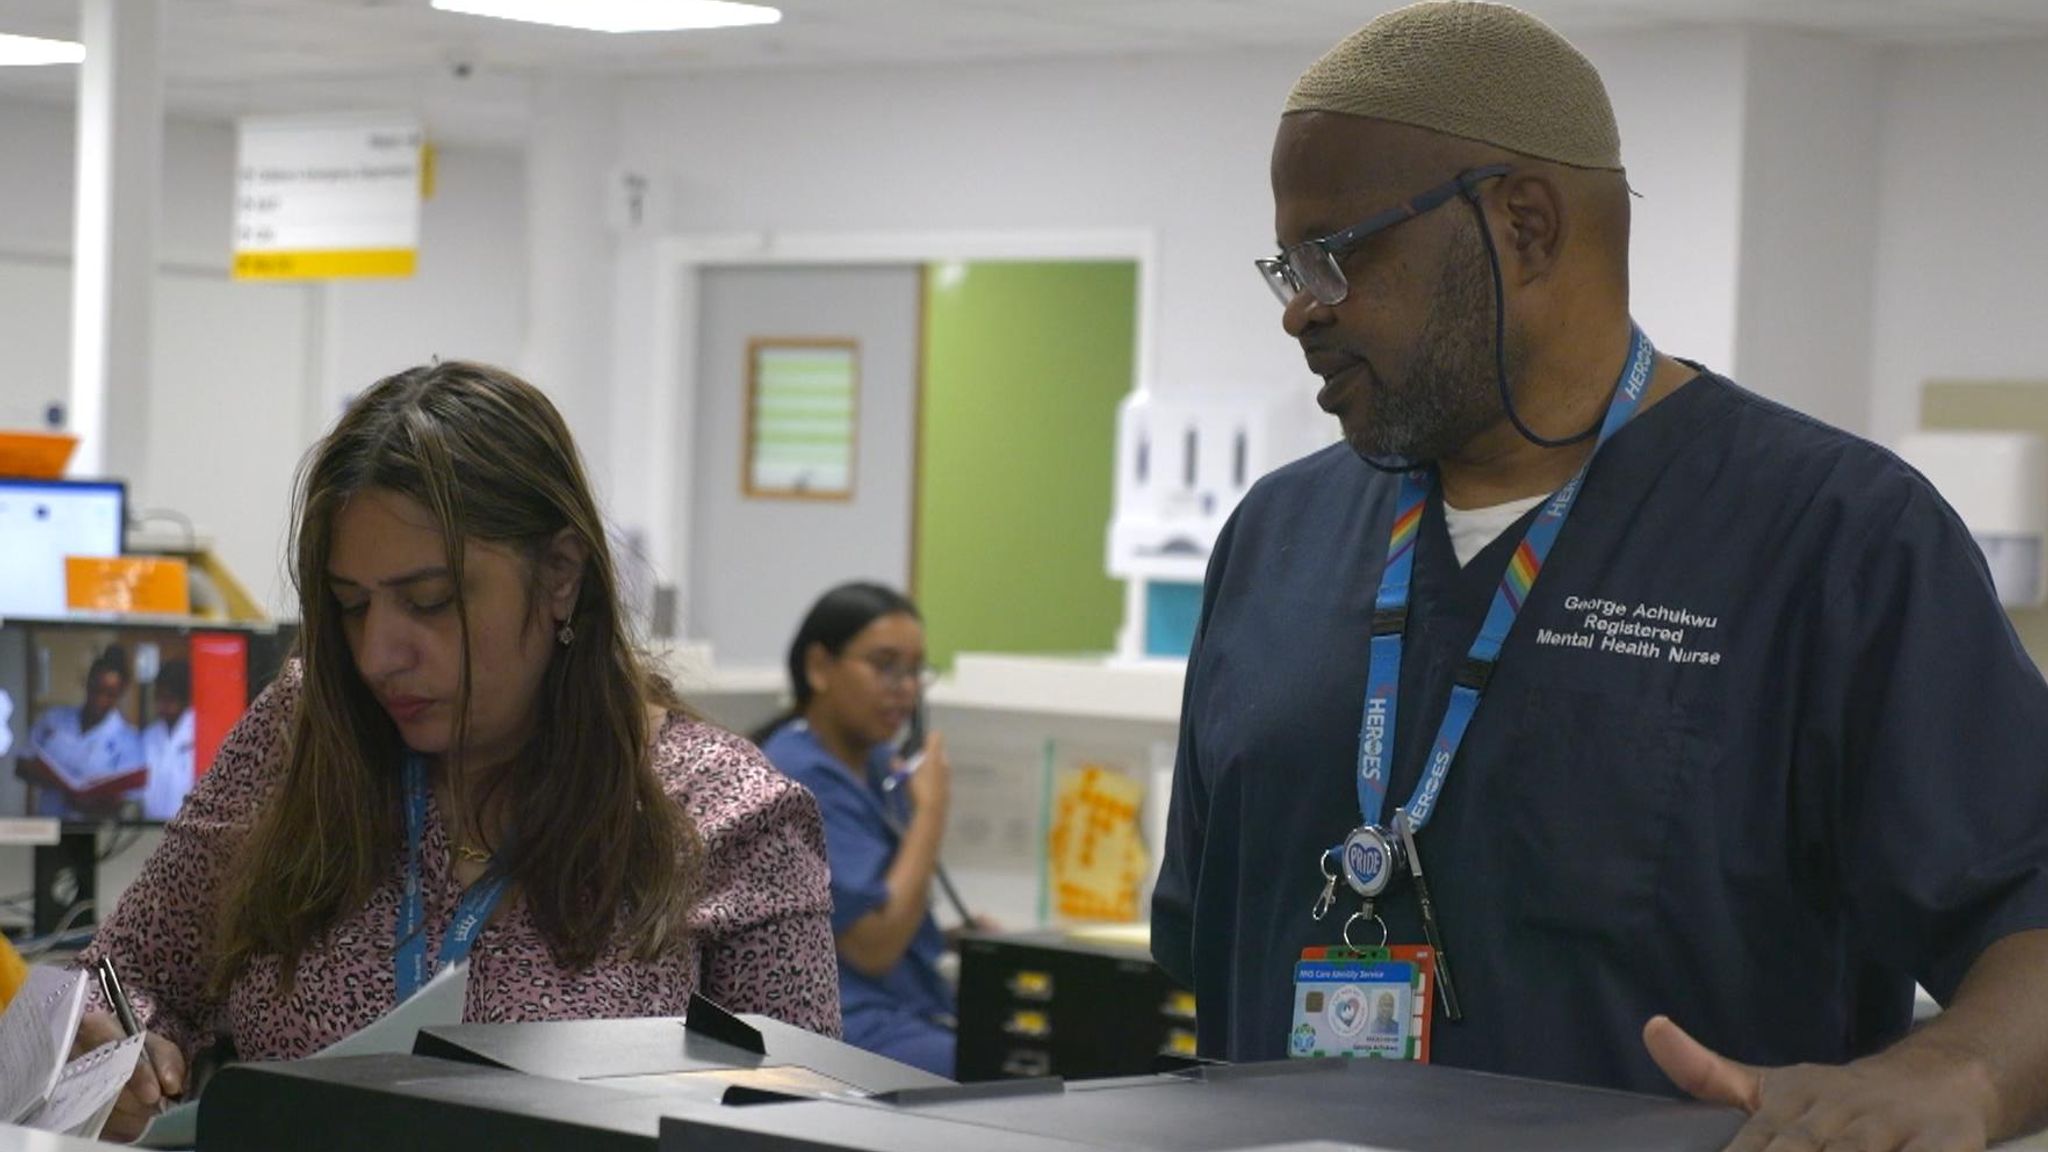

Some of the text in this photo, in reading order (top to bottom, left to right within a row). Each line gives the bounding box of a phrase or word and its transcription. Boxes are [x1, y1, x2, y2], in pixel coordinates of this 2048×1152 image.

[1564, 596, 1718, 629] George Achukwu
[1584, 614, 1684, 644] Registered
[1536, 628, 1721, 666] Mental Health Nurse
[1363, 698, 1387, 780] HEROES
[1350, 846, 1380, 875] PRIDE
